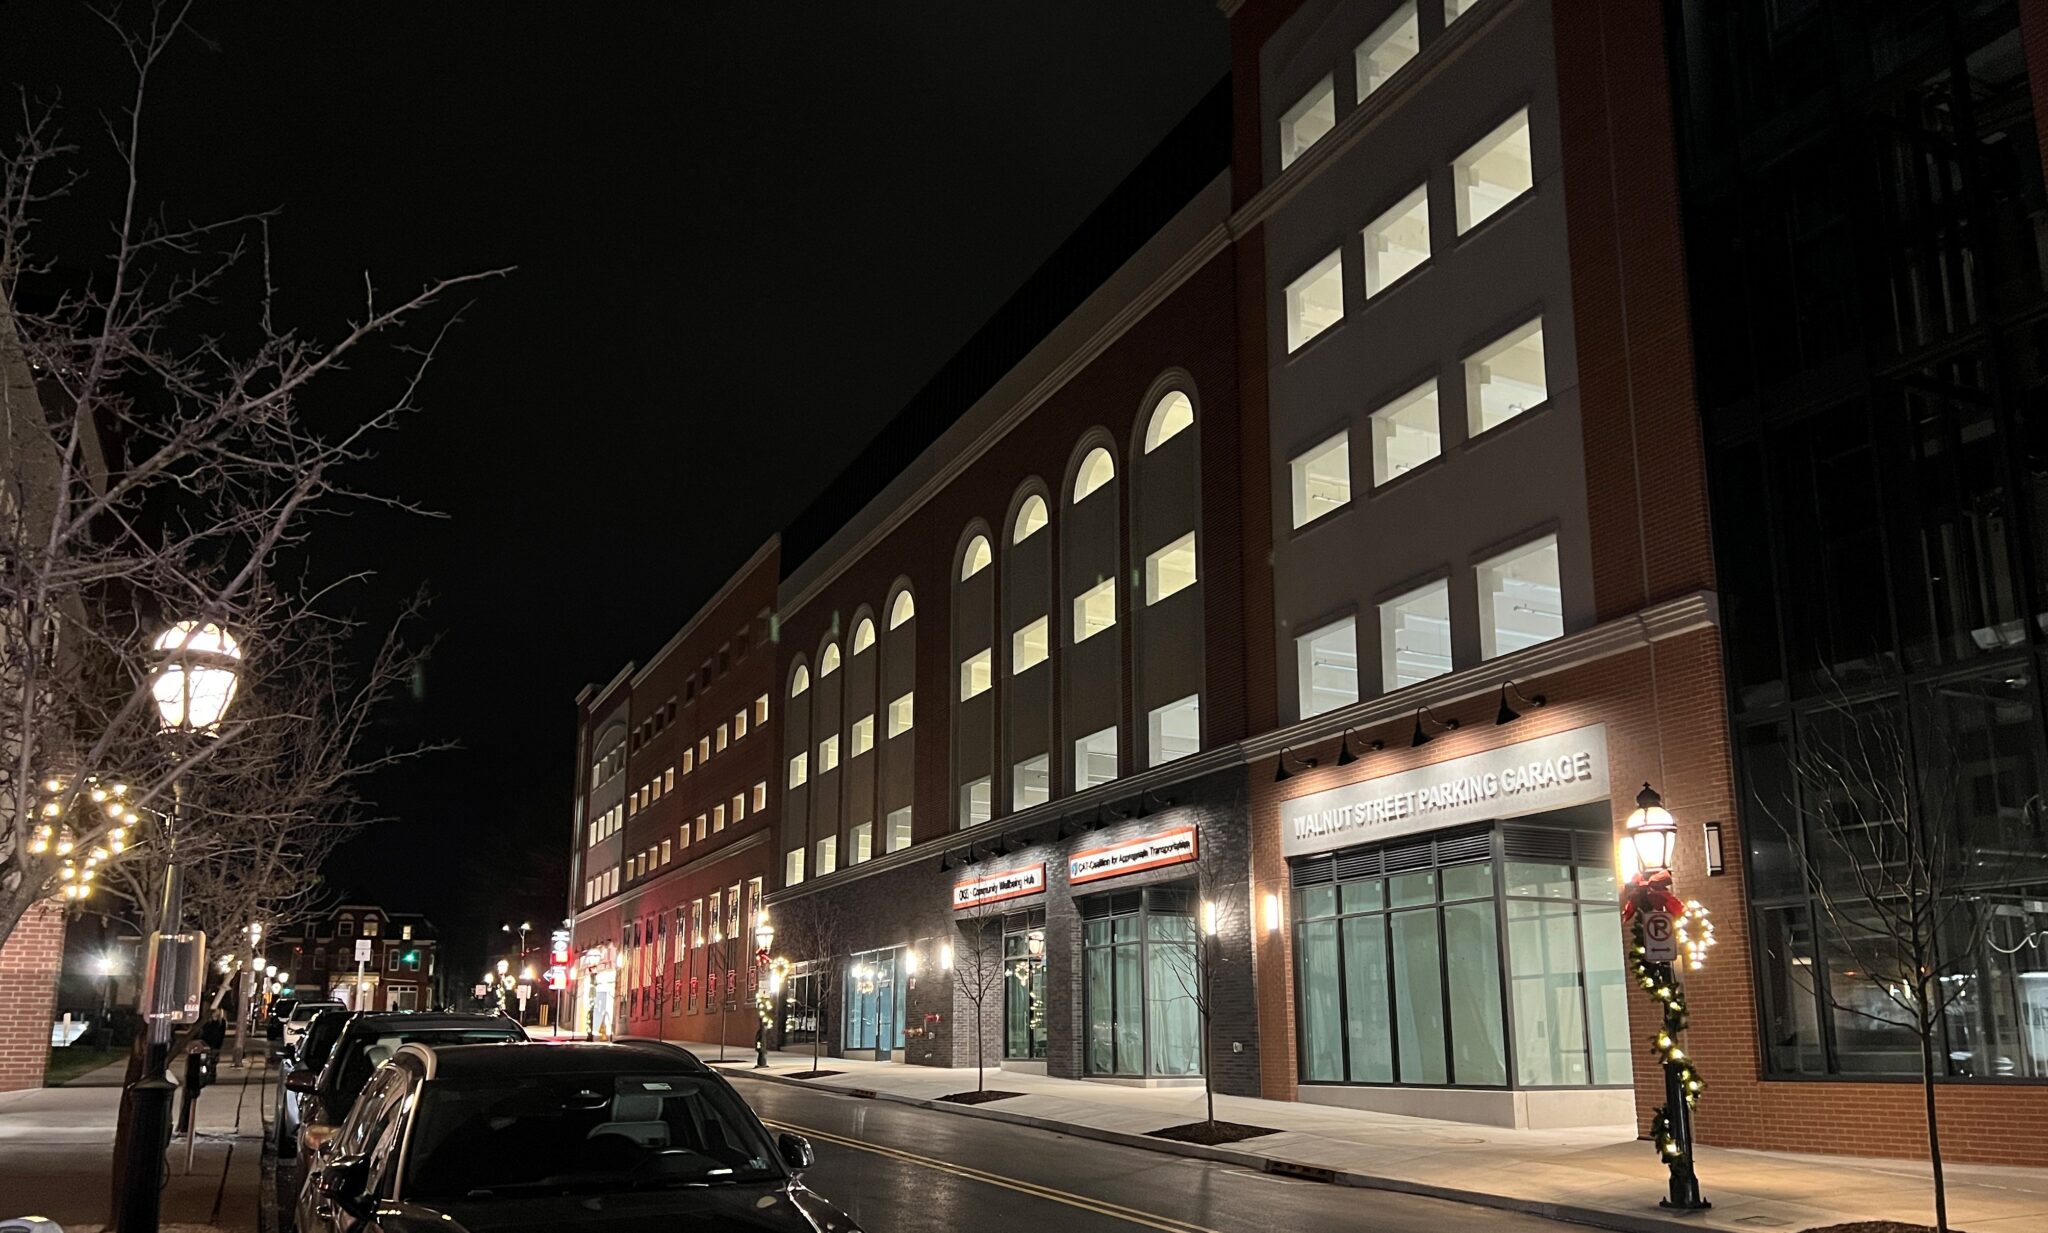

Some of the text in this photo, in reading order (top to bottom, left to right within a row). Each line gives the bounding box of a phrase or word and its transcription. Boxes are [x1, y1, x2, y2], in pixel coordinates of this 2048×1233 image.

[1293, 751, 1590, 837] WALNUT STREET PARKING GARAGE
